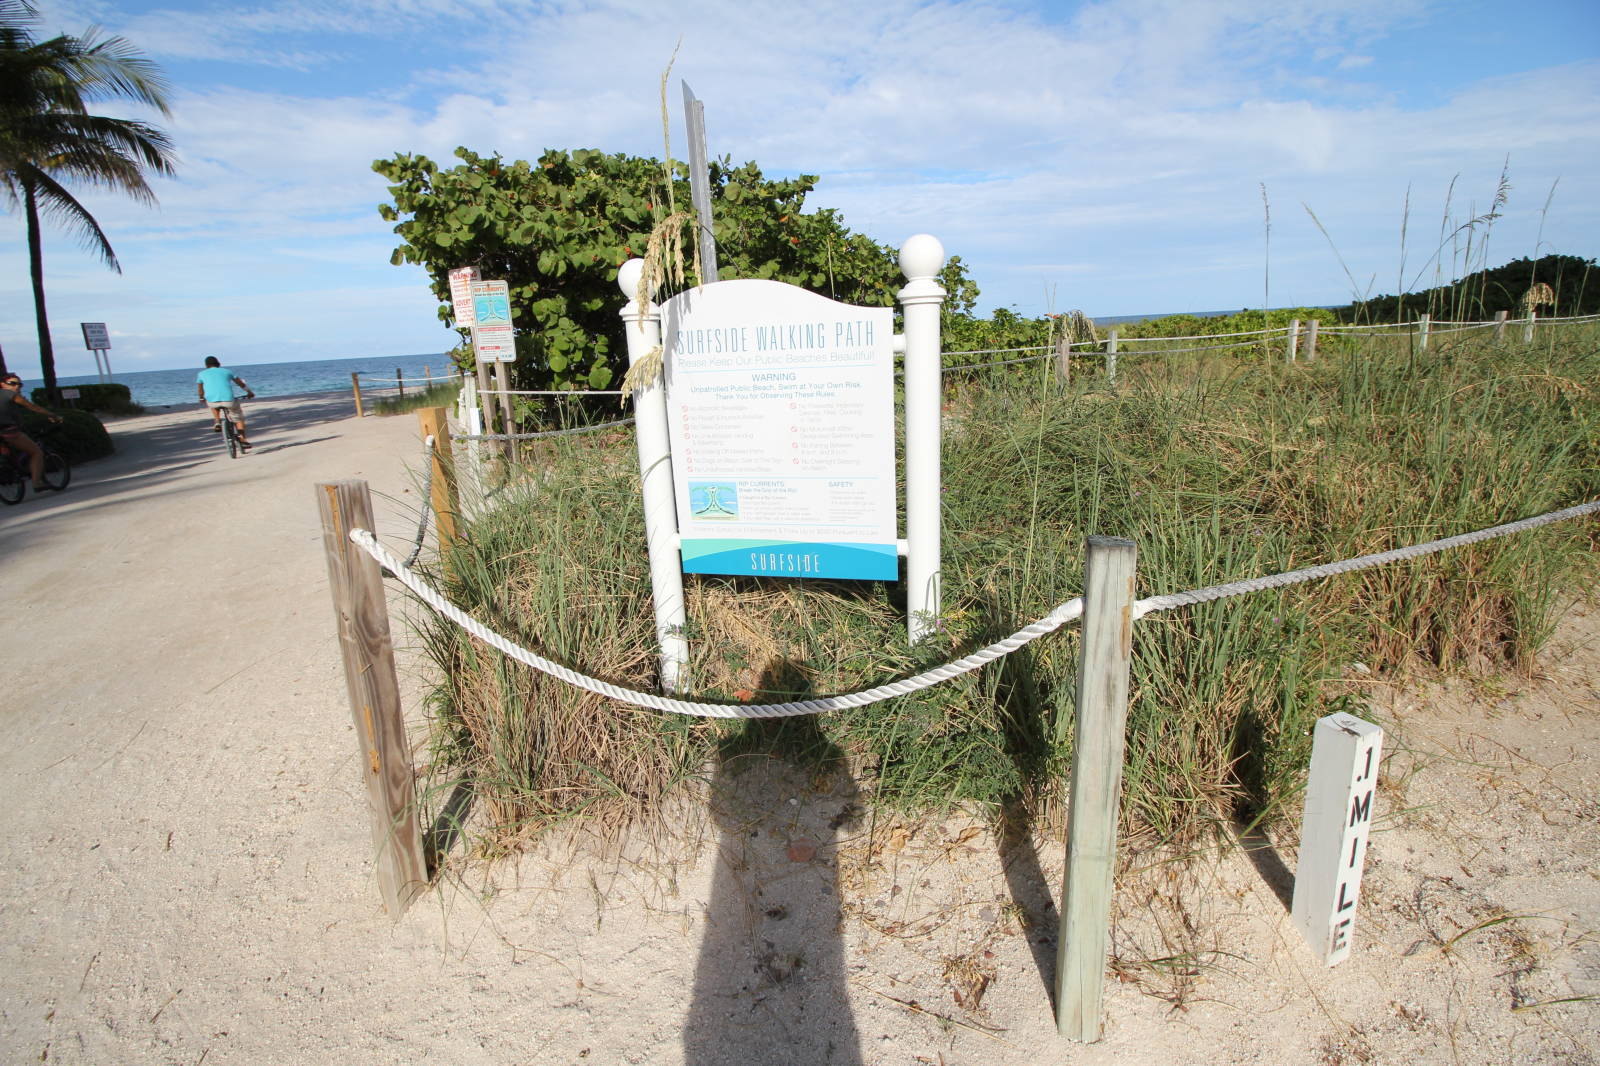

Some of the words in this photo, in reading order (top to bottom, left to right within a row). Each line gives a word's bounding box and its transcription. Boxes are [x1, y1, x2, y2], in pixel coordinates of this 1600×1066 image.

[678, 327, 748, 355] SURFSIDE
[756, 323, 825, 351] WALKING
[835, 320, 873, 348] PATH
[679, 357, 706, 368] Please
[710, 356, 733, 368] Keep
[736, 356, 752, 366] Our
[755, 354, 783, 365] Public
[786, 352, 827, 363] Beaches
[752, 372, 796, 382] WARNING
[731, 384, 752, 392] Public
[778, 382, 797, 391] Swim
[808, 382, 825, 390] Your
[827, 381, 844, 389] Own
[735, 392, 748, 400] You
[760, 391, 793, 400] Observing
[750, 552, 820, 572] SURFSIDE
